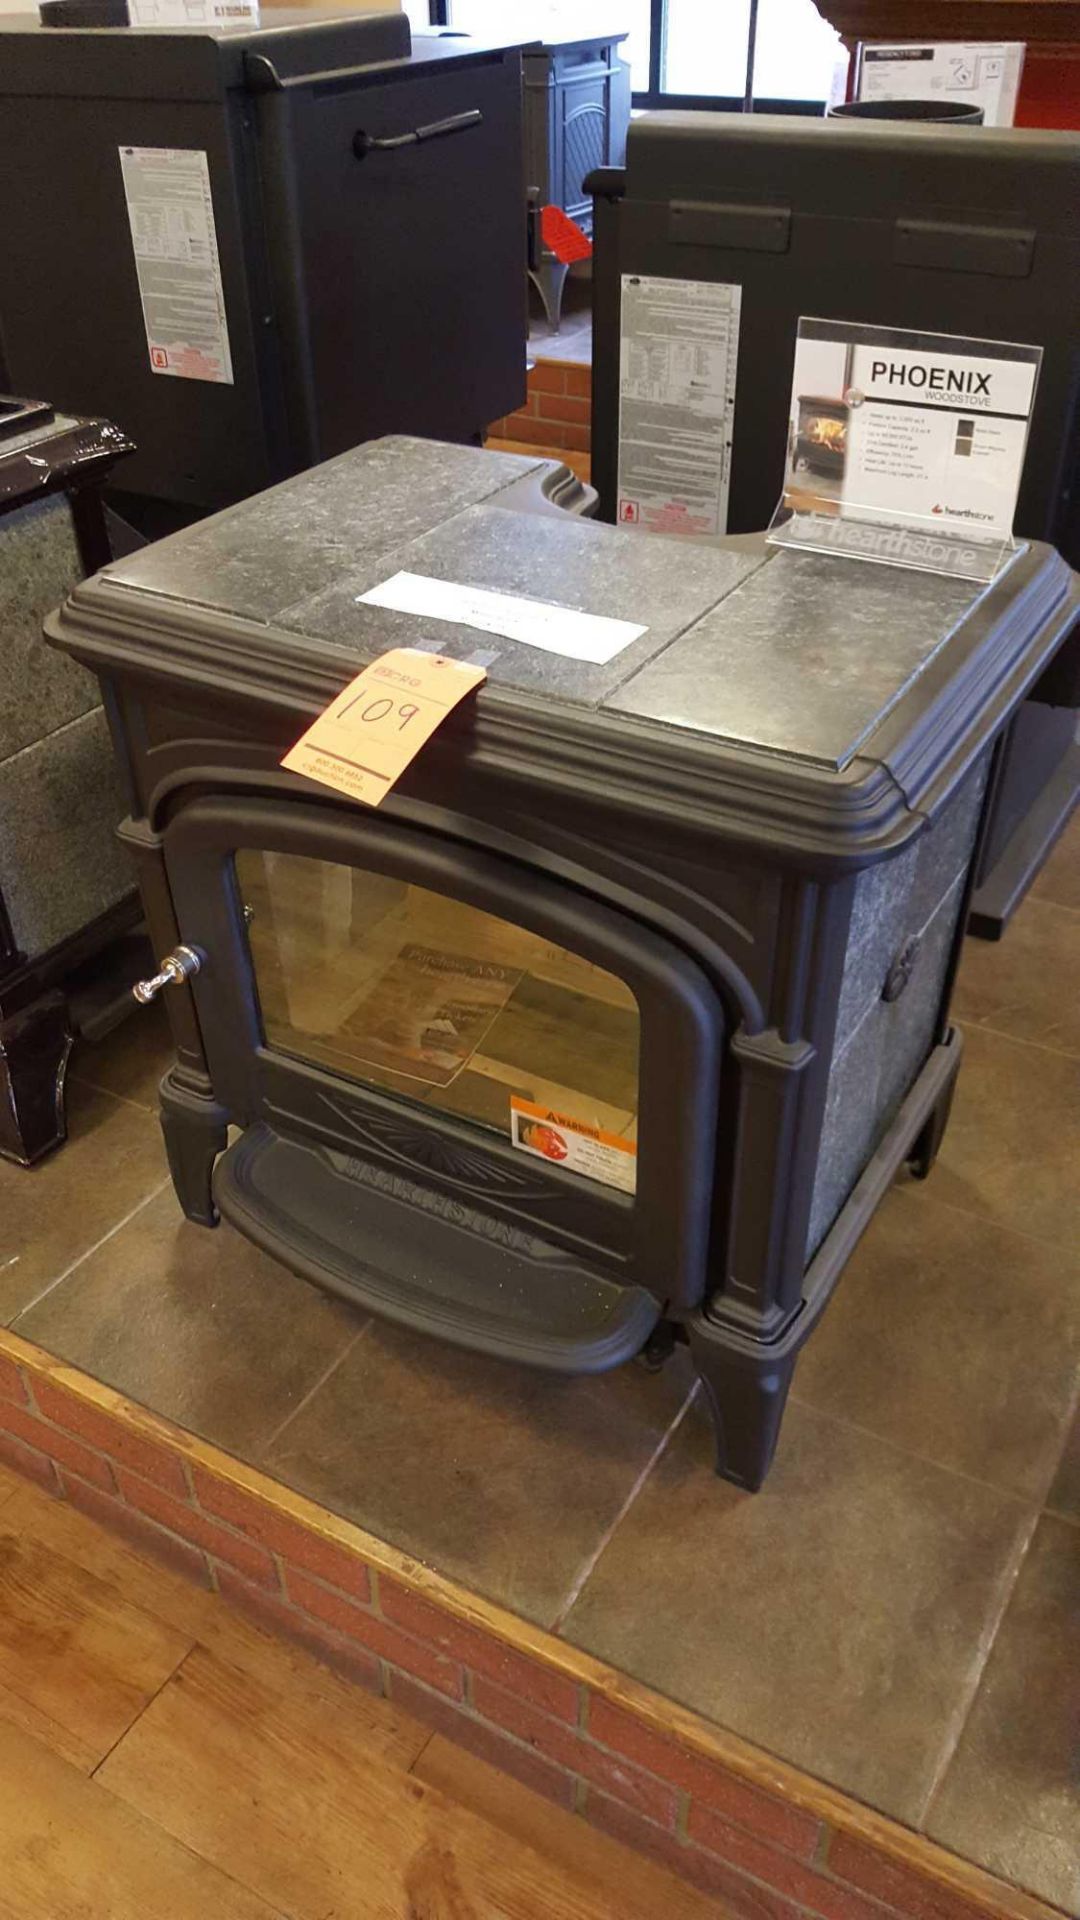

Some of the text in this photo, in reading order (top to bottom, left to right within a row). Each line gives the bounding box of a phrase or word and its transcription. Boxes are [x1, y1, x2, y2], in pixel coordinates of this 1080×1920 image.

[870, 361, 992, 396] PHOENIX
[924, 391, 992, 407] WOODSTOVE
[945, 505, 994, 521] hearthstone
[831, 518, 977, 567] hearthstone
[336, 689, 420, 731] 109
[559, 1118, 600, 1139] WARNING
[347, 1156, 534, 1251] HEARTHSTONE
